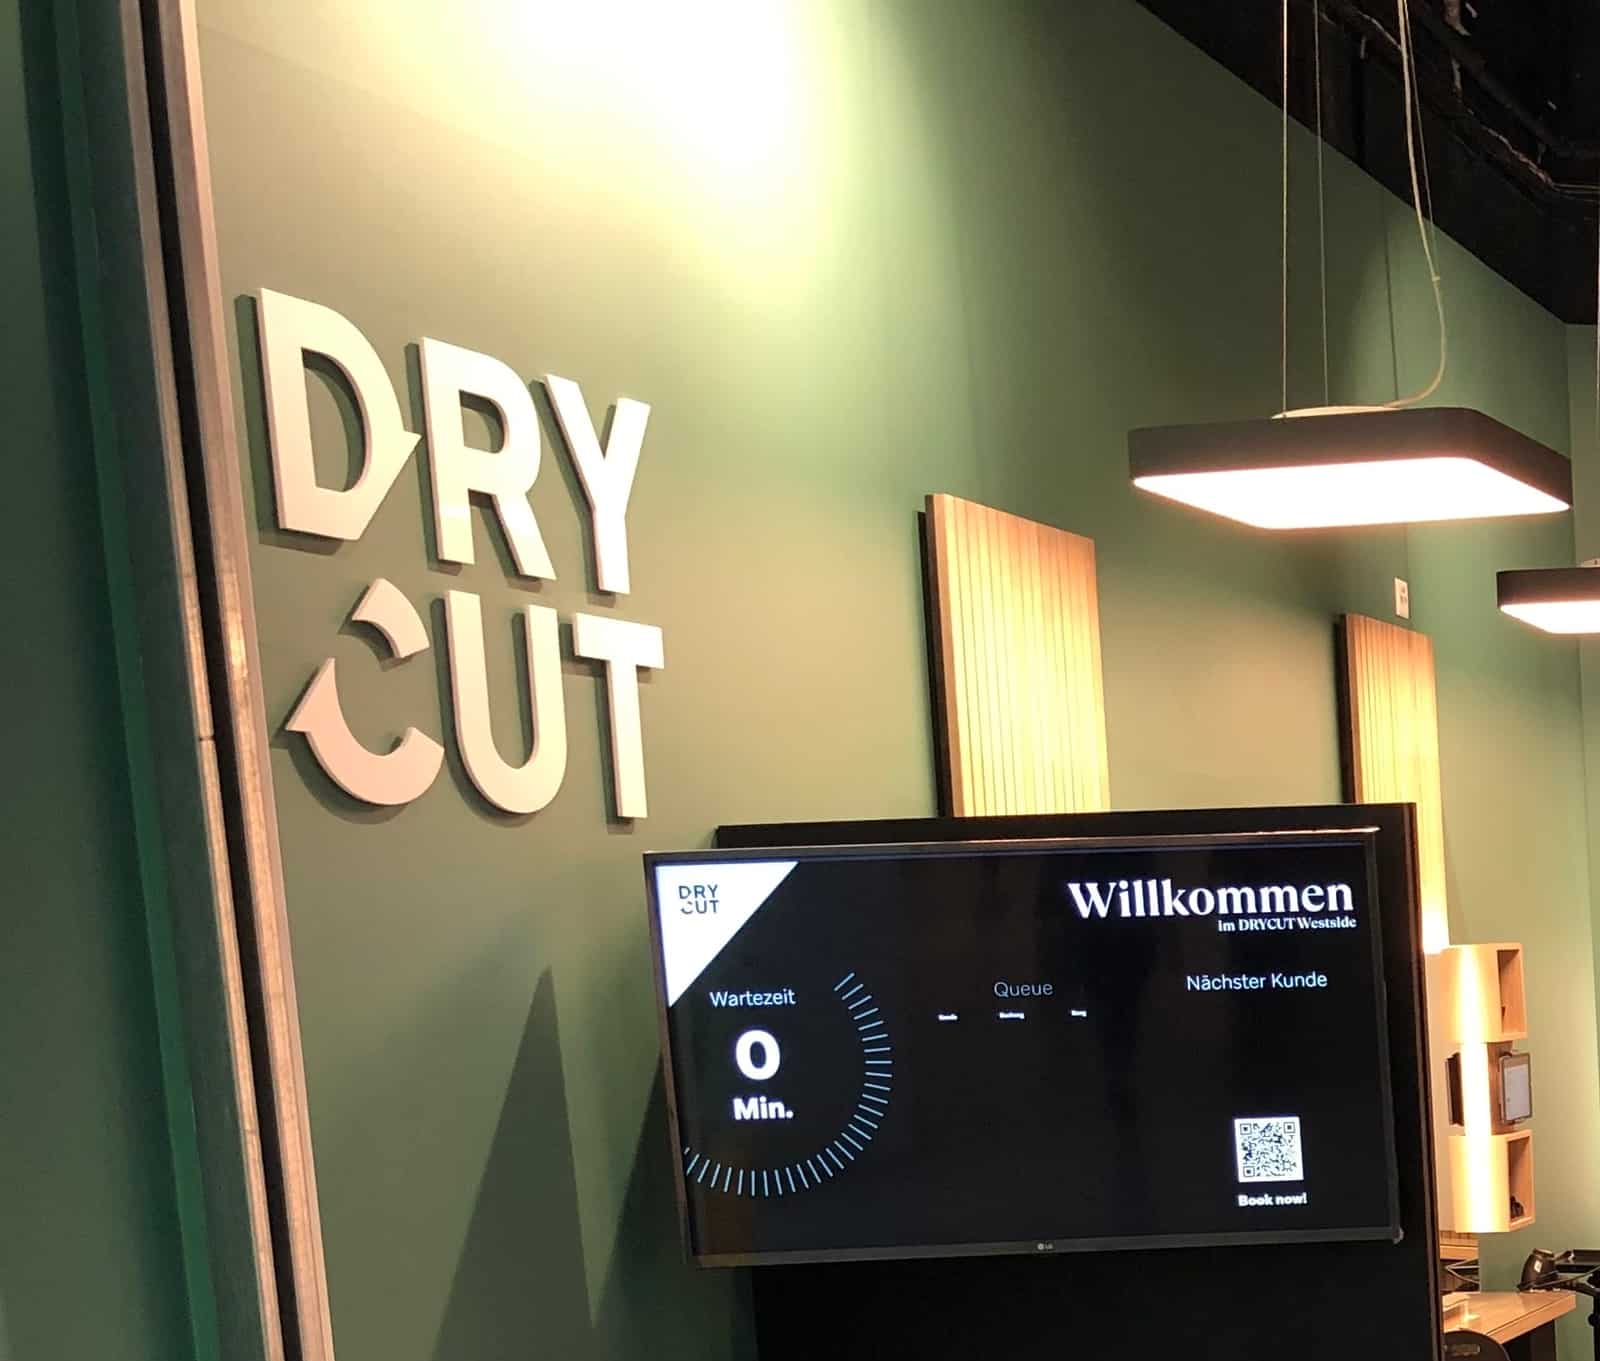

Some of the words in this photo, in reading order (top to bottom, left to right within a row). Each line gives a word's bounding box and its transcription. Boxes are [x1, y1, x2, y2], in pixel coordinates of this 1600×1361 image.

[256, 286, 652, 596] DRY
[285, 577, 665, 820] CUT
[678, 883, 718, 900] DRY
[1068, 879, 1354, 920] Willkommen
[680, 899, 719, 915] CUT
[1238, 916, 1297, 931] DRYCUT
[1297, 915, 1357, 930] Westside
[993, 981, 1053, 998] Queue
[1187, 972, 1267, 992] Nächster
[1271, 970, 1328, 989] Kunde
[709, 988, 796, 1007] Wartezeit
[735, 1030, 781, 1080] 0
[733, 1095, 794, 1121] Min.
[1238, 1193, 1274, 1207] Book
[1275, 1191, 1308, 1206] now!
